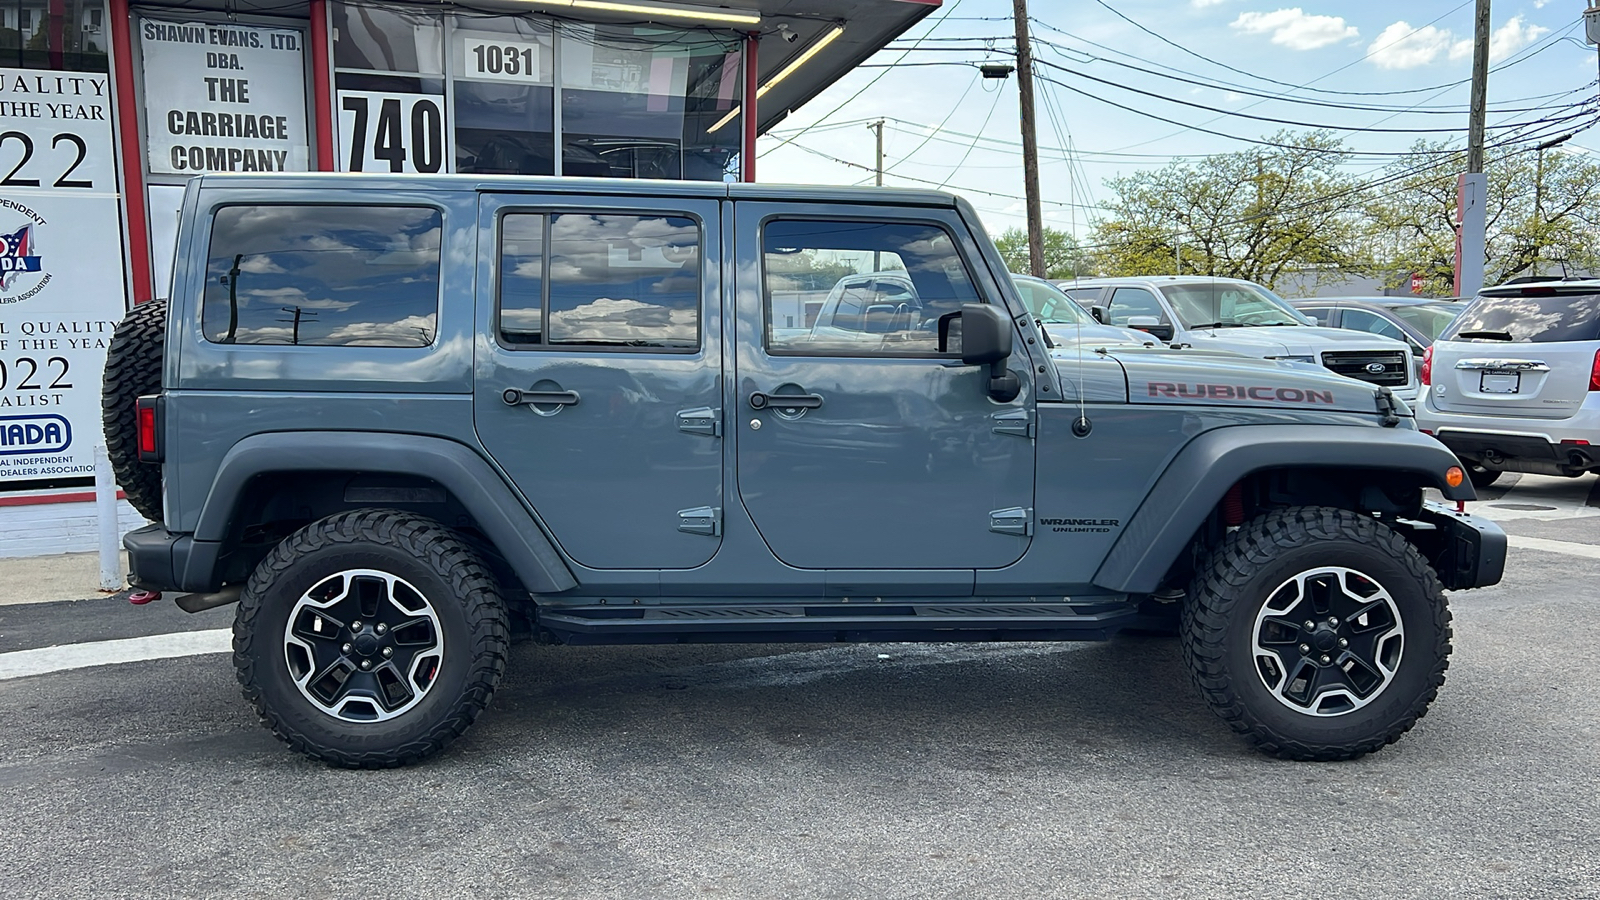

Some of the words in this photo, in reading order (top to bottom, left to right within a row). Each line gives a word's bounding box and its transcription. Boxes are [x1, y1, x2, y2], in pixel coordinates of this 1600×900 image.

[144, 23, 206, 44] SHAWN
[210, 29, 264, 49] EVANS.
[271, 33, 301, 51] LTD.
[207, 52, 244, 70] DBA.
[472, 44, 534, 76] 1031
[204, 77, 250, 103] THE
[46, 103, 105, 121] YEAR
[167, 110, 288, 139] CARRIAGE
[342, 96, 442, 173] 740
[170, 145, 288, 172] COMPANY
[0, 198, 47, 226] ENDENT
[17, 272, 53, 302] ASSOCIATION
[21, 321, 120, 337] QUALITY
[18, 339, 58, 350] THE
[1148, 382, 1334, 404] RUBICON
[1, 467, 38, 477] DEALERS
[13, 455, 73, 466] INDEPENDENT
[1040, 518, 1119, 527] WRANGLER
